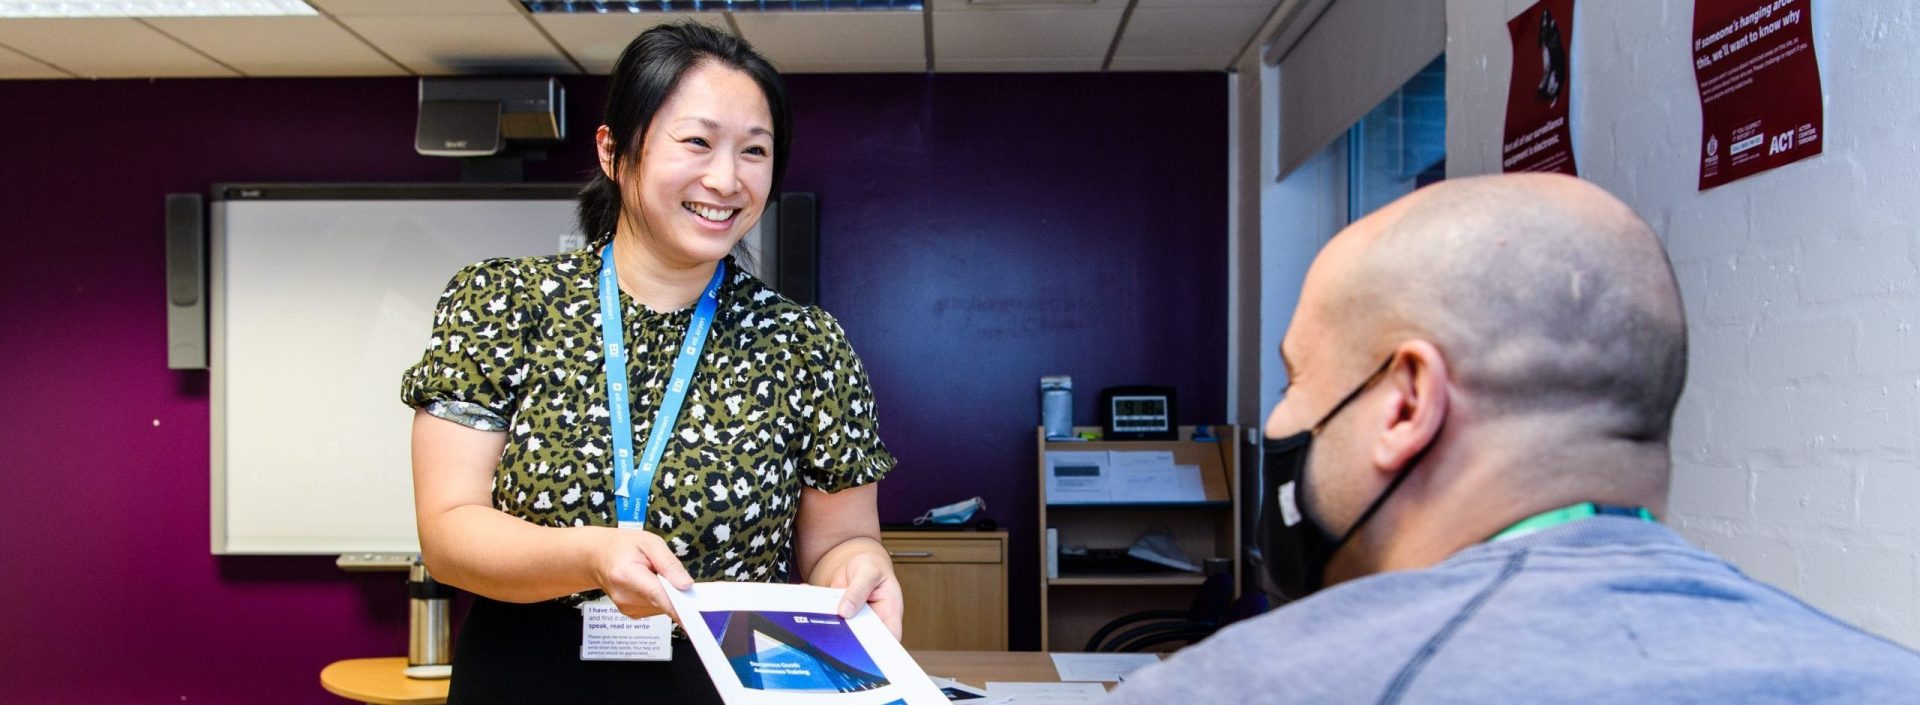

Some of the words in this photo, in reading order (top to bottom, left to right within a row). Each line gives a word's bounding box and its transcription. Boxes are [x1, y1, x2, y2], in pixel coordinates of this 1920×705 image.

[1697, 54, 1712, 69] this,
[1712, 43, 1729, 61] we'll
[1729, 34, 1749, 52] want
[1749, 31, 1758, 43] to
[1759, 19, 1781, 39] know
[1783, 9, 1800, 26] why
[1701, 20, 1739, 48] someone's
[1740, 4, 1772, 28] hanging
[1768, 129, 1794, 156] ACT
